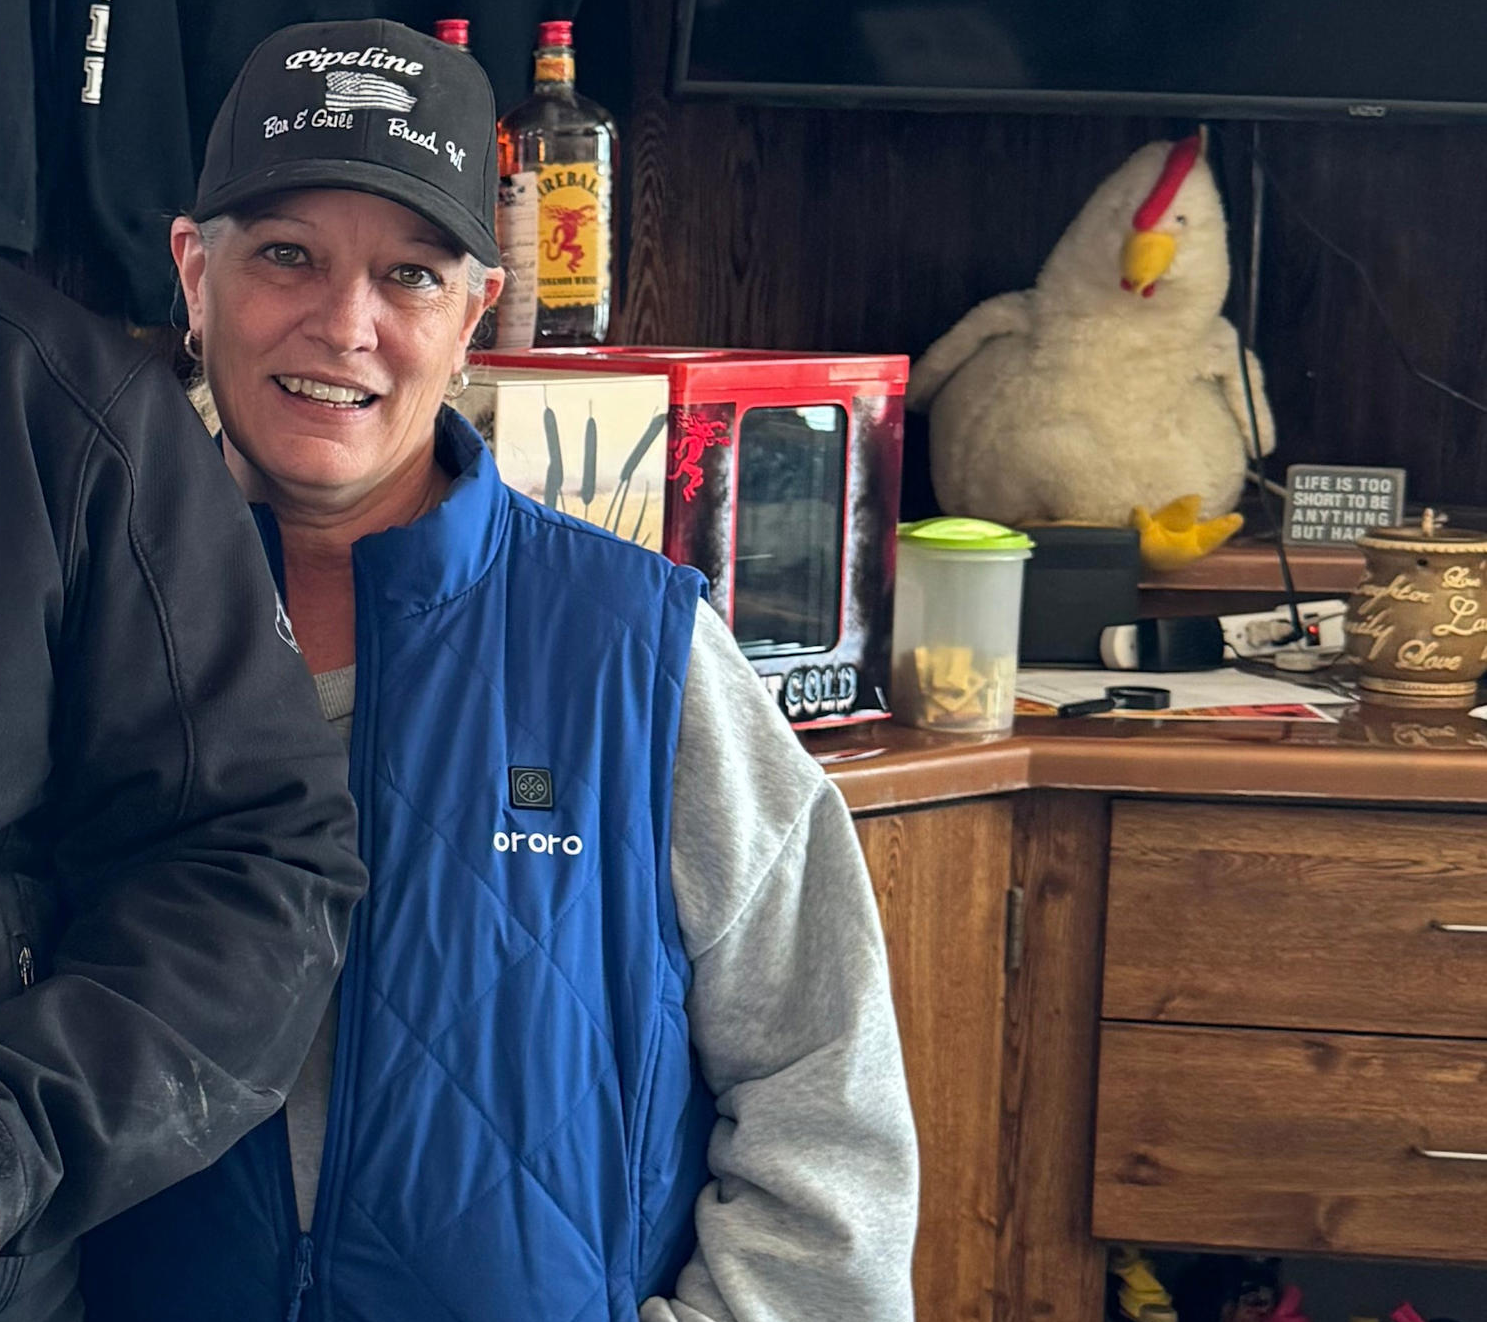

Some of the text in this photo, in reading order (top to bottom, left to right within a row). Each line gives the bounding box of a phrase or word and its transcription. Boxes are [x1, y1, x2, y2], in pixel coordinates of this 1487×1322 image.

[285, 46, 424, 76] Pipeline
[263, 115, 289, 139] Bar
[311, 110, 353, 130] Grill
[1294, 475, 1392, 493] LIFE IS TOO
[1293, 491, 1390, 510] SHORT TO BE
[1291, 508, 1390, 526] ANYTHING
[1291, 523, 1325, 539] BUT
[786, 664, 857, 717] COLD
[493, 831, 583, 855] ororo
